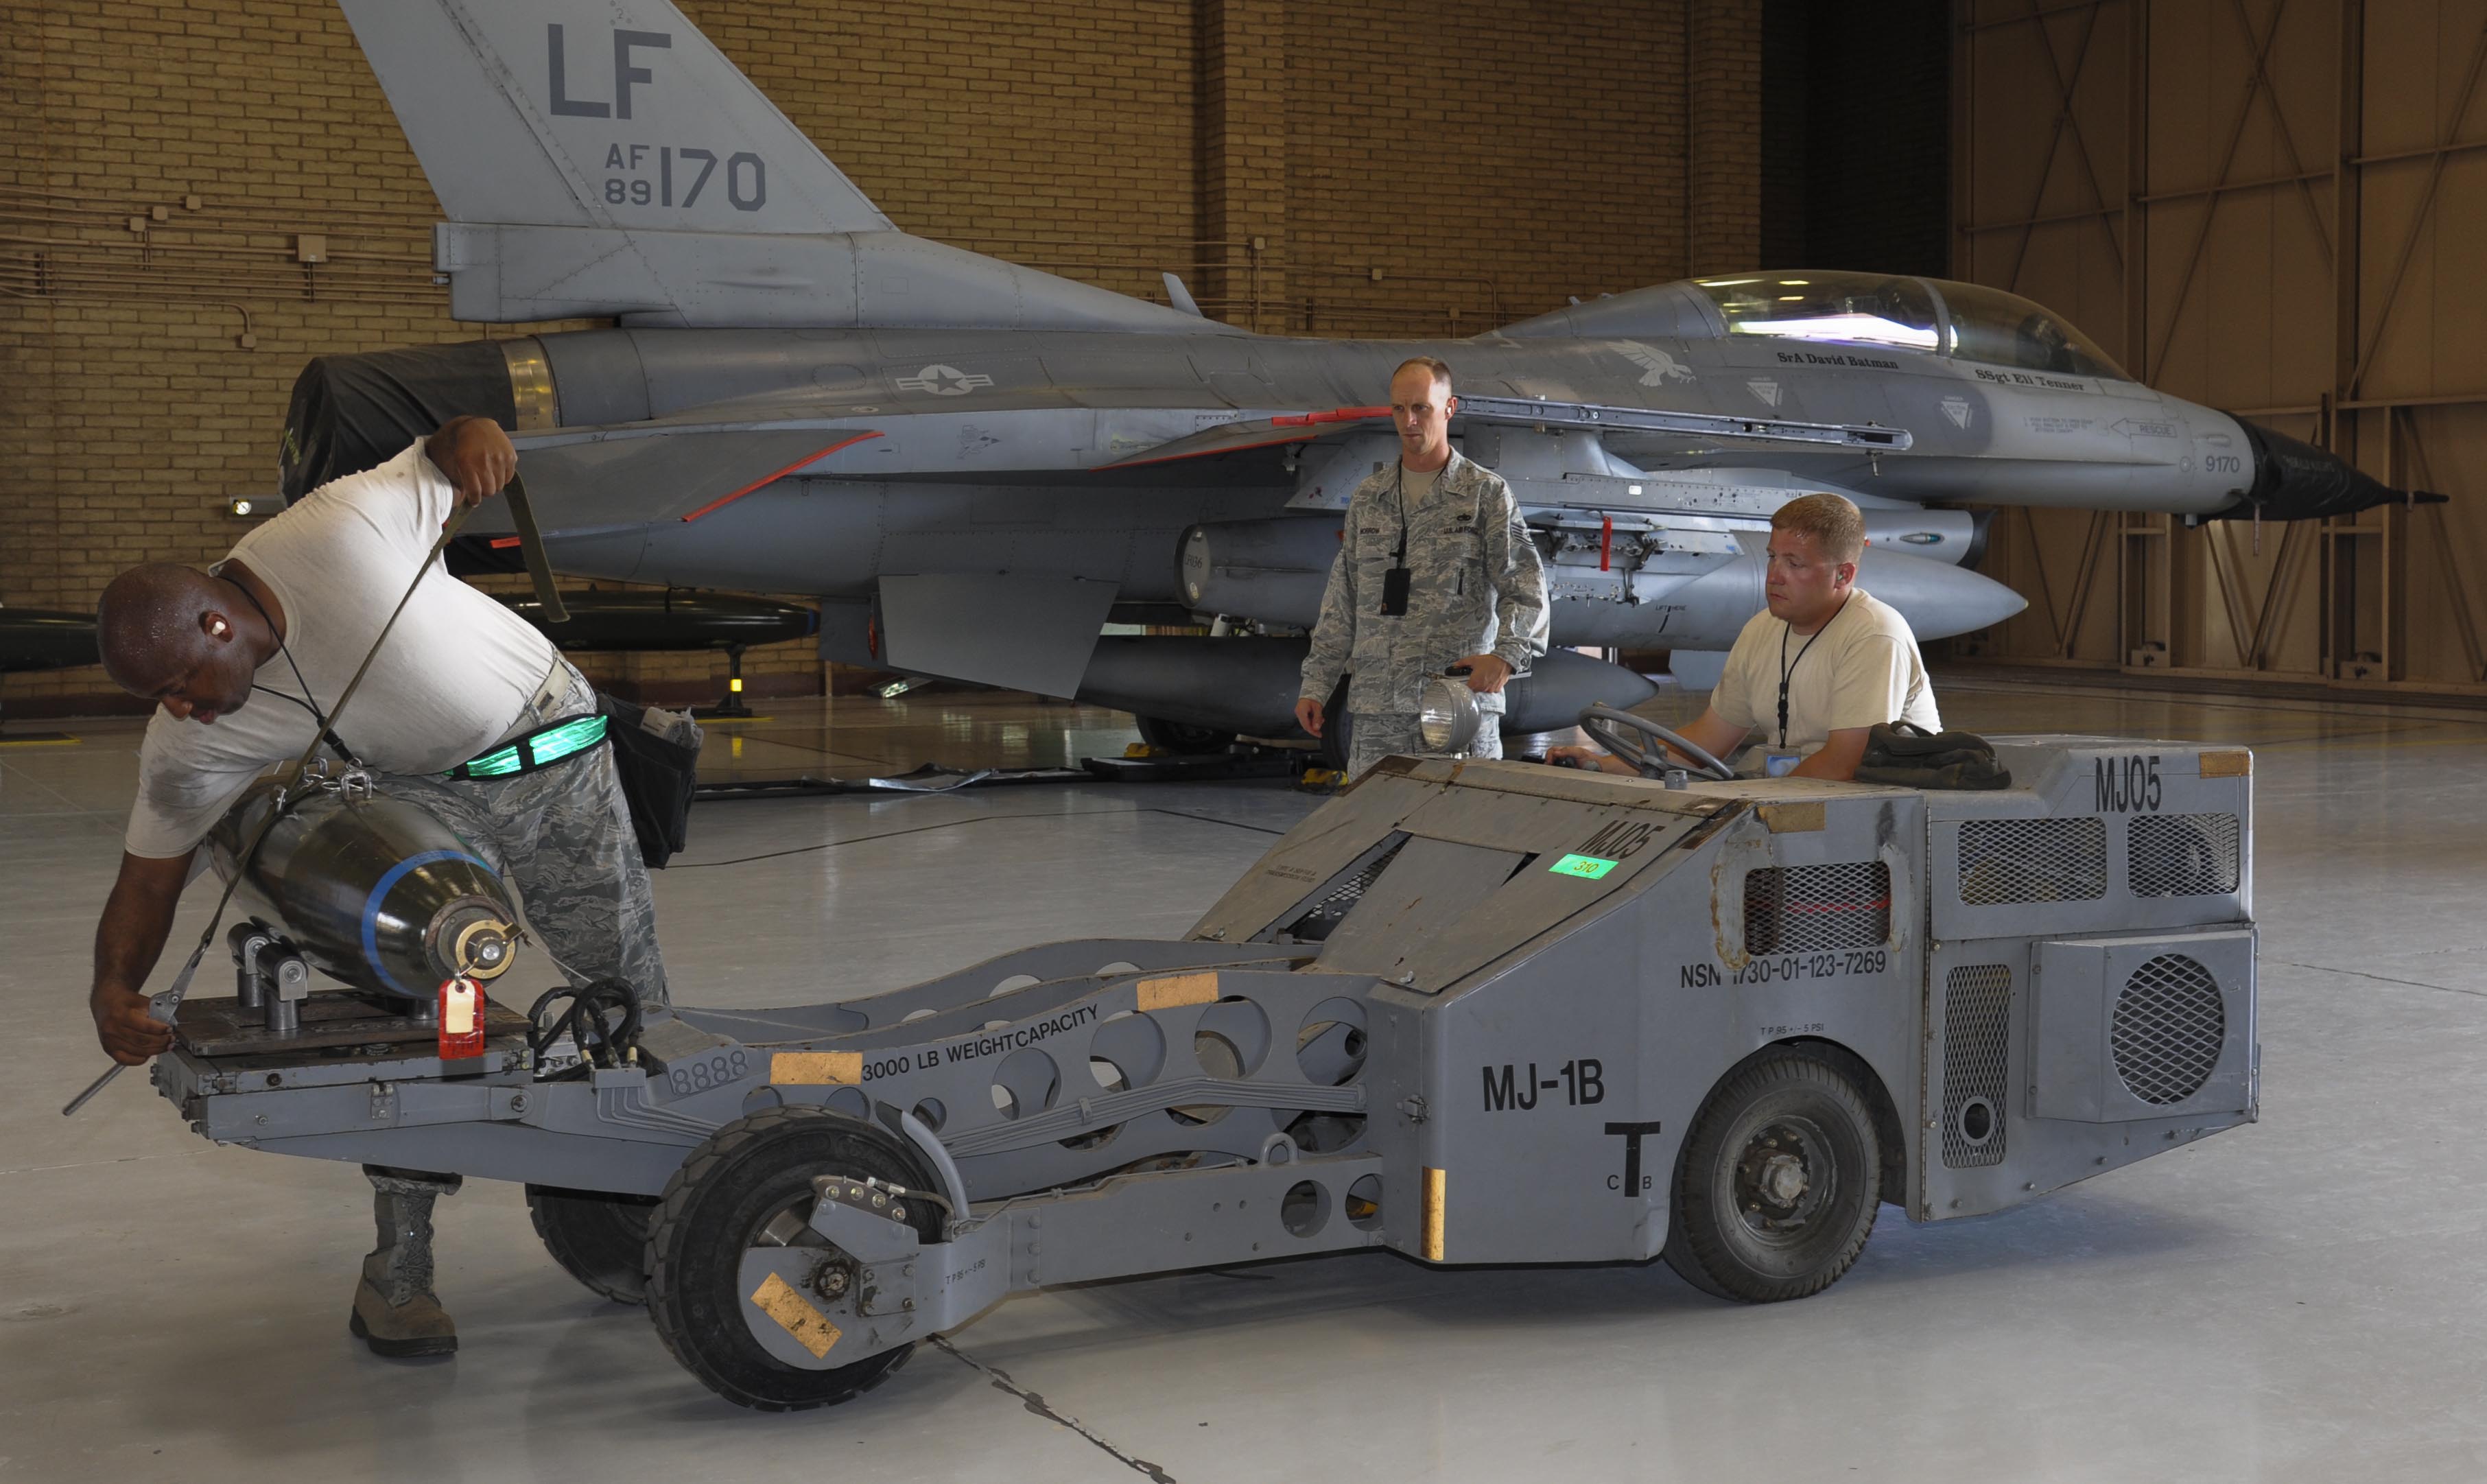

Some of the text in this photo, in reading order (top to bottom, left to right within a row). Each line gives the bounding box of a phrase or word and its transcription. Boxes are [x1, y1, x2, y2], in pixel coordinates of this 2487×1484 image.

[548, 23, 672, 119] LF
[605, 143, 650, 169] AF
[605, 147, 766, 211] 89 170
[1777, 352, 1899, 369] SrA David Batman
[1975, 369, 2010, 384] SSgt
[2036, 376, 2085, 391] Tenner
[2139, 424, 2171, 435] RESCUE
[2205, 455, 2241, 473] 9170
[1574, 861, 1599, 873] 310
[1681, 963, 1721, 988] NSN
[1812, 1023, 1824, 1032] PSI
[672, 1050, 748, 1096] 8888
[862, 1057, 910, 1081] 3000
[917, 1050, 939, 1070] LB
[1483, 1059, 1604, 1111] MJ-1B
[1605, 1121, 1661, 1197] C T B
